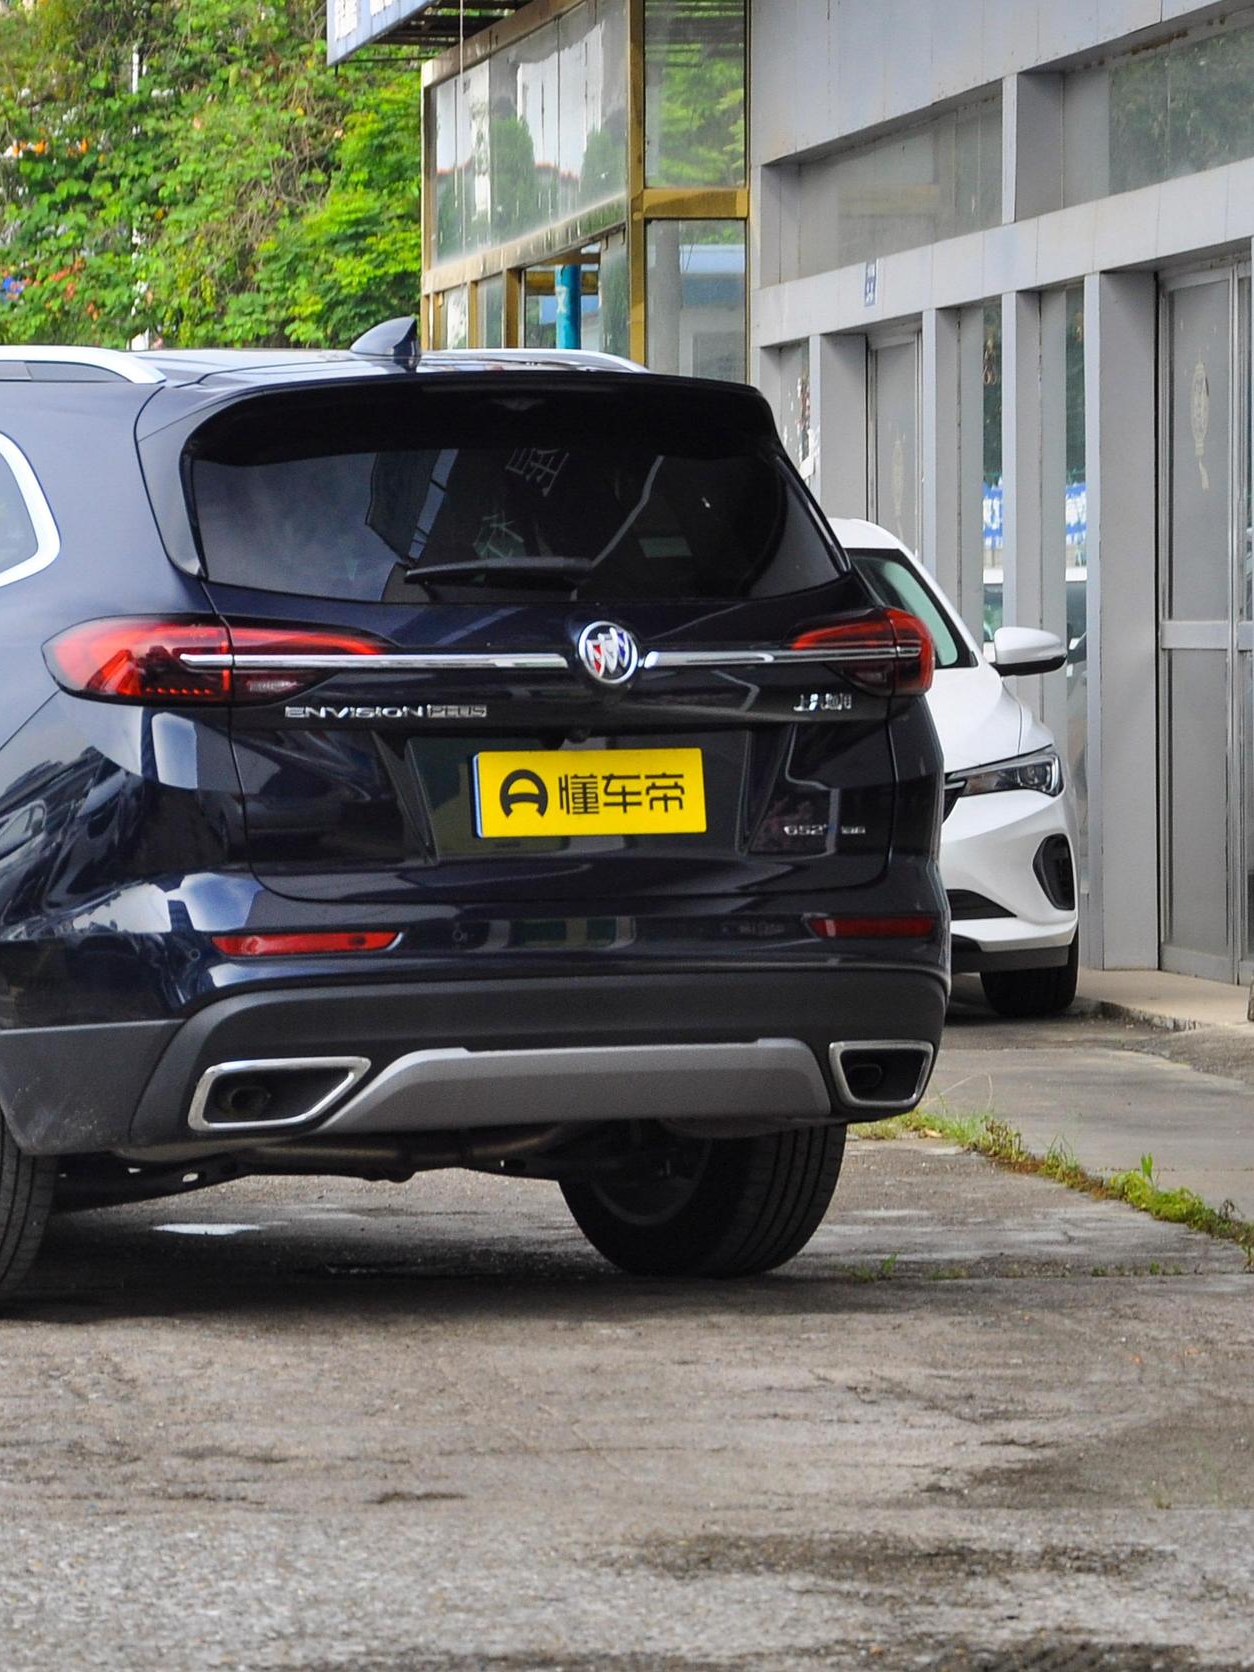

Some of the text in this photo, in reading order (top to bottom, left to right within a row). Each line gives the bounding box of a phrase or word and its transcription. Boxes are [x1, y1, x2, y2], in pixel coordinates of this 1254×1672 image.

[285, 705, 423, 718] ENVISION
[558, 772, 686, 815] 懂车帝
